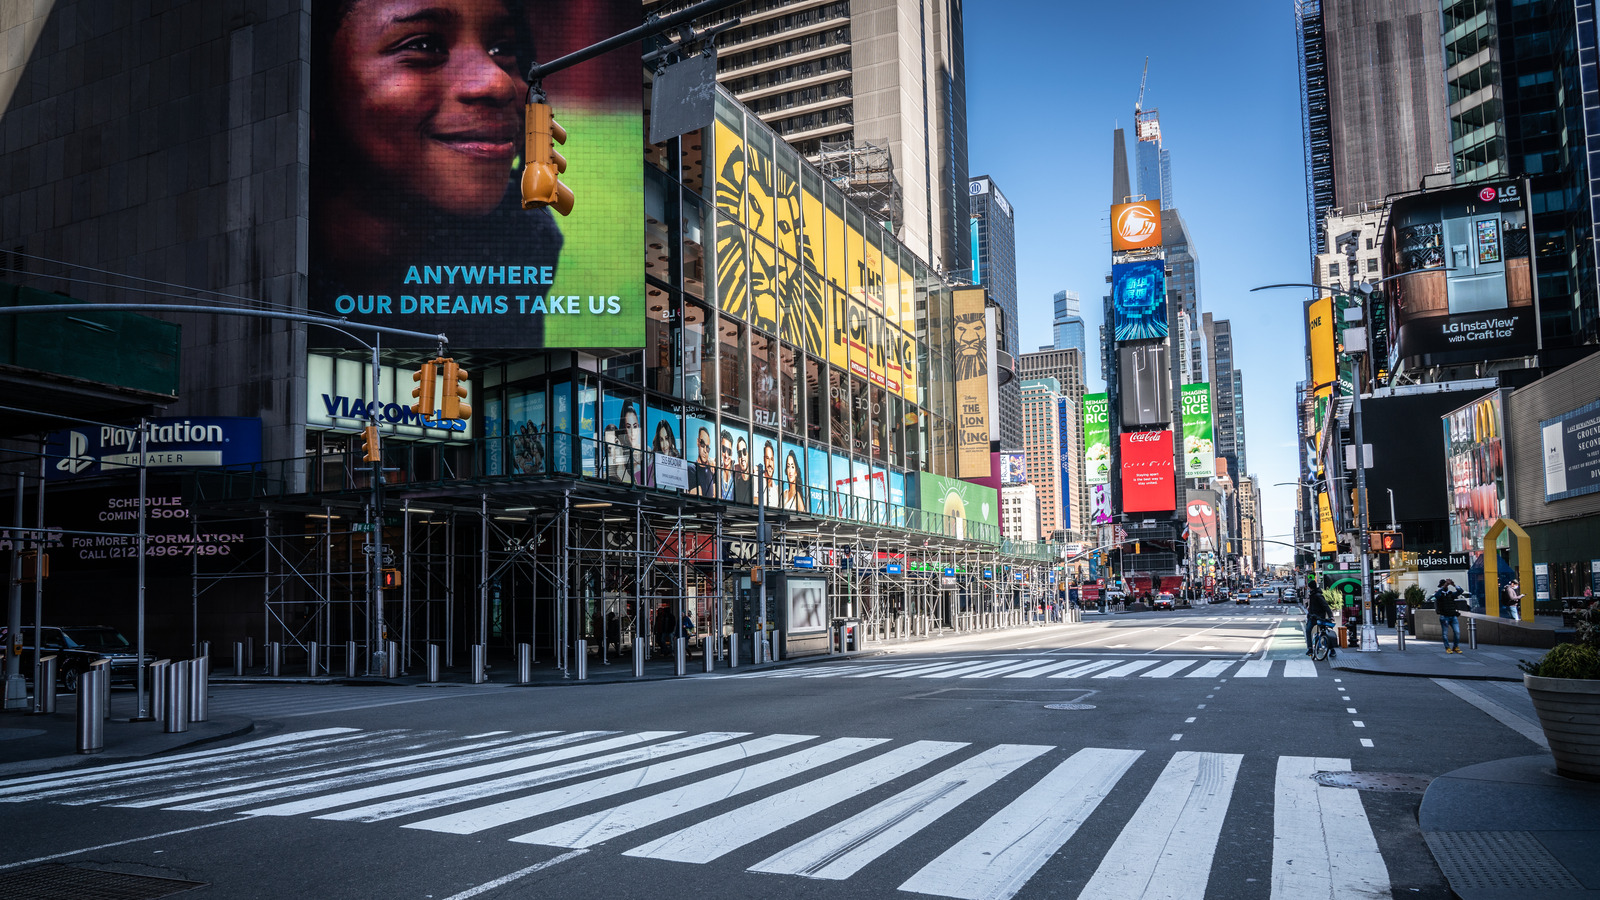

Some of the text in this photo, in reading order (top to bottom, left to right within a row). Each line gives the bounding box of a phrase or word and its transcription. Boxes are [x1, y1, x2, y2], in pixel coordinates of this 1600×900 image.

[1498, 186, 1517, 198] LG
[404, 266, 554, 284] ANYWHERE
[335, 295, 621, 314] OUR DREAMS TAKE US
[832, 276, 874, 350] LION
[1442, 323, 1458, 334] LG
[1466, 330, 1494, 341] Craft
[963, 404, 980, 412] THE
[1086, 404, 1107, 413] YOU
[960, 414, 984, 428] LION
[1086, 413, 1107, 424] RIC
[1059, 406, 1068, 449] NOVOTEL
[959, 429, 988, 446] KING
[125, 454, 183, 464] THATER
[108, 496, 182, 509] SCHEDULE
[72, 534, 244, 547] FOR MORE IFORMATION
[80, 550, 106, 559] CALL
[145, 545, 231, 556] 496-7490
[728, 541, 806, 562] SKCHERS
[1405, 555, 1467, 568] sunglass hut
